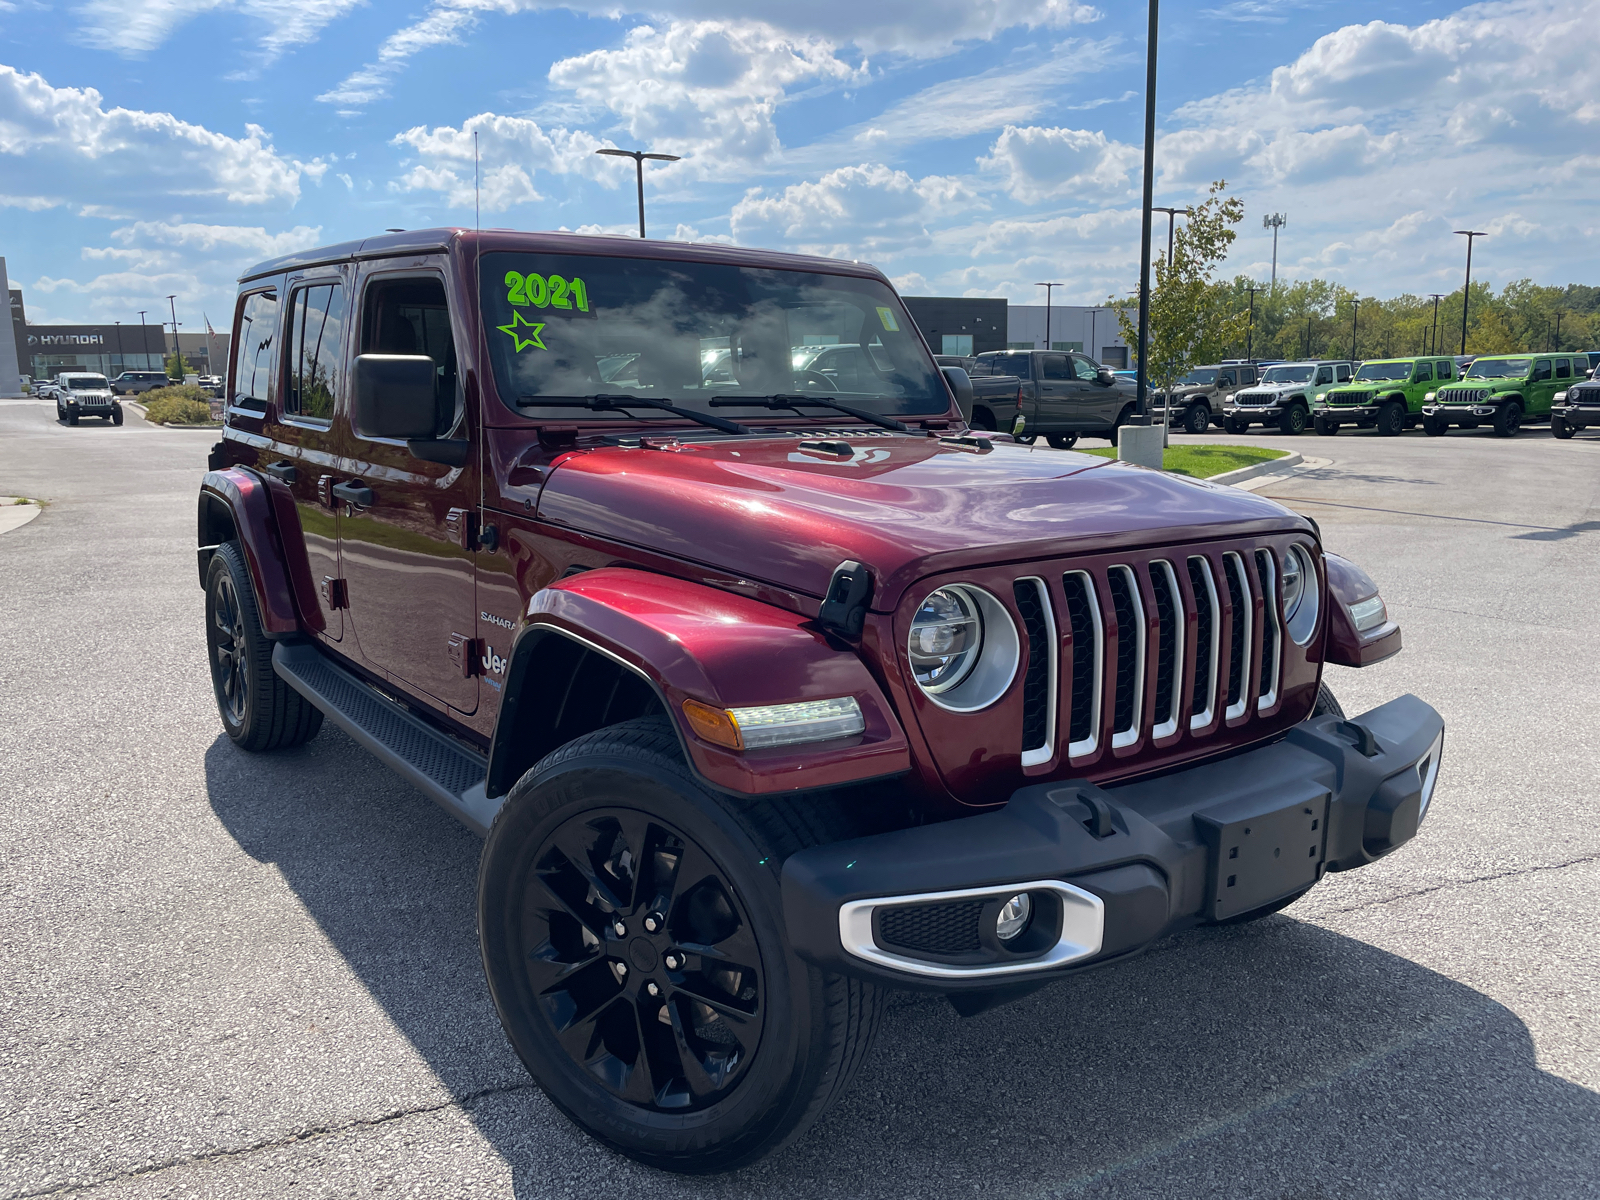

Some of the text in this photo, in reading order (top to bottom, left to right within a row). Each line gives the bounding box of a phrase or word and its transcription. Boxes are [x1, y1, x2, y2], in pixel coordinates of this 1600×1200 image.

[505, 271, 589, 312] 2021
[41, 335, 103, 344] HYUNDAI
[481, 611, 516, 630] SAHARA
[482, 646, 506, 675] Jee
